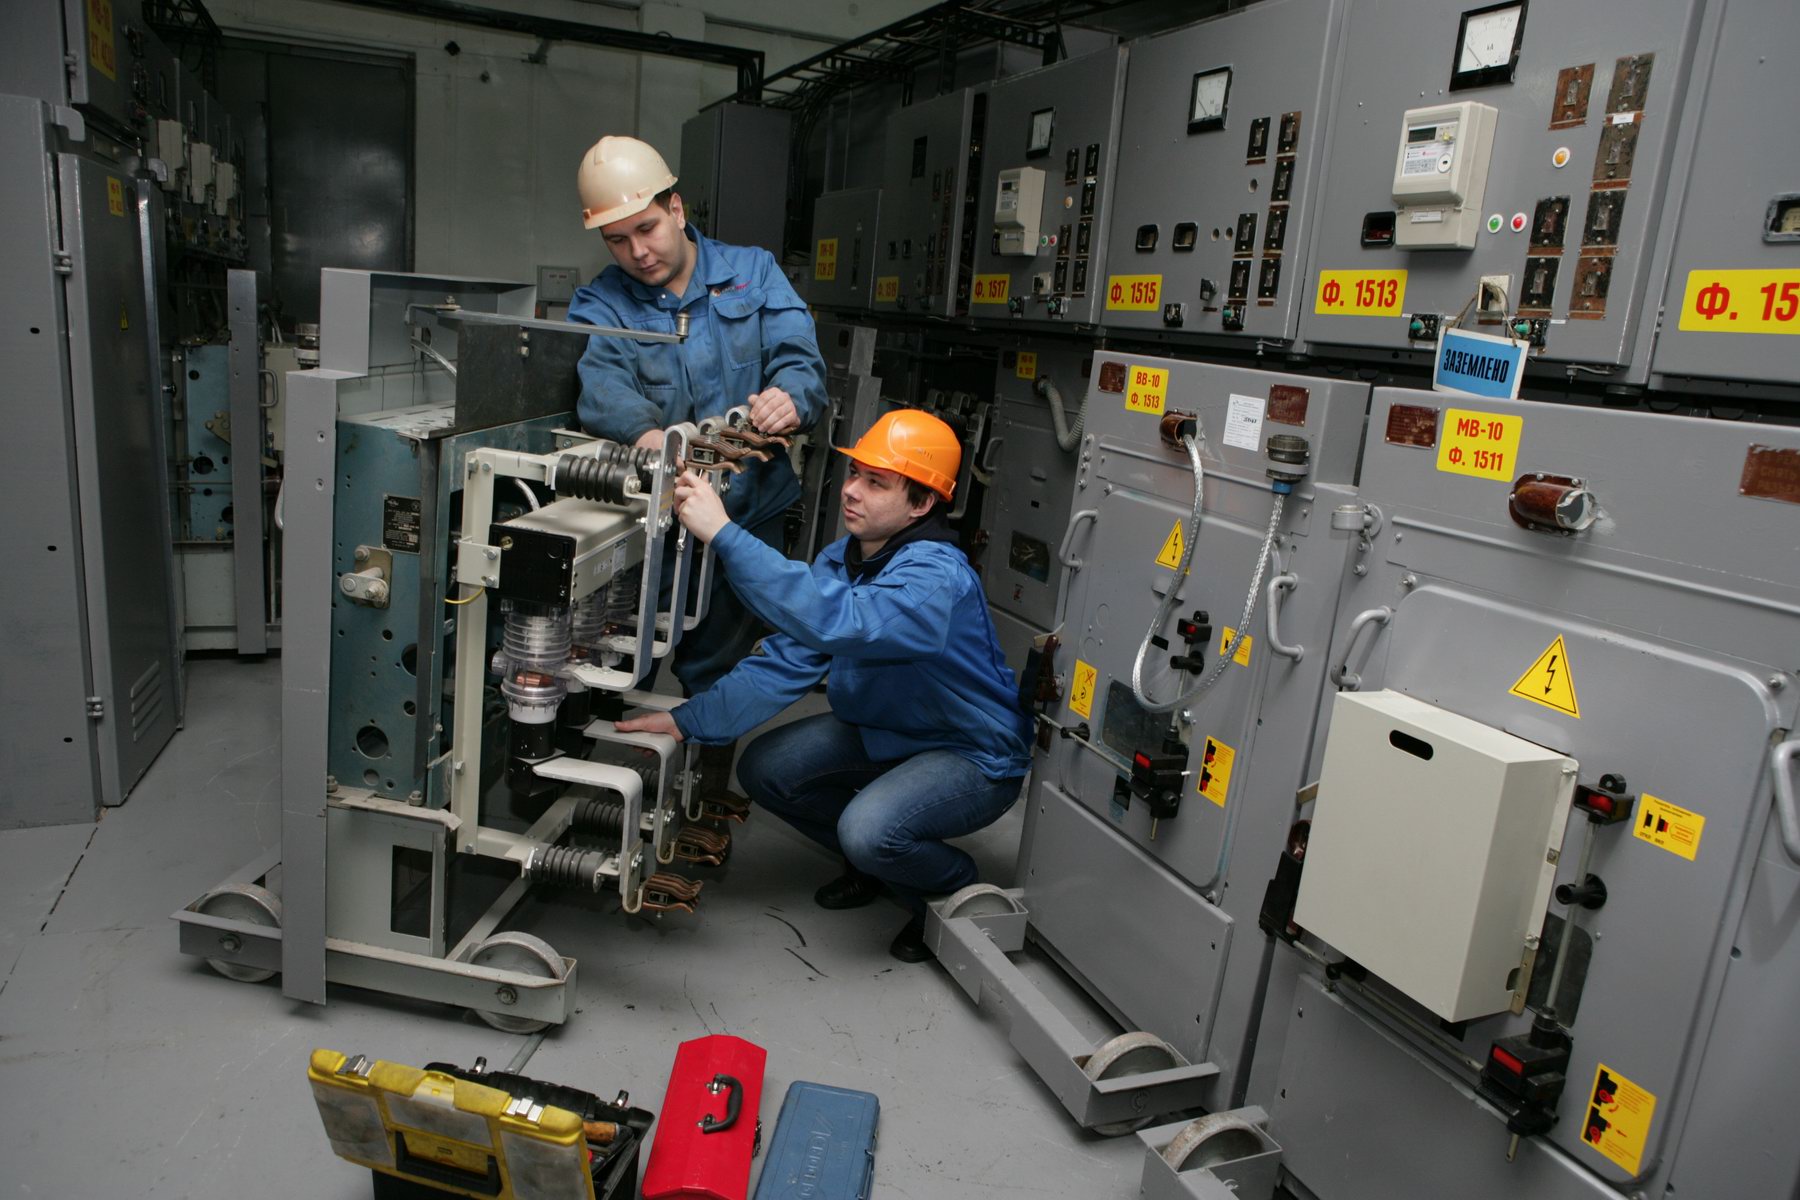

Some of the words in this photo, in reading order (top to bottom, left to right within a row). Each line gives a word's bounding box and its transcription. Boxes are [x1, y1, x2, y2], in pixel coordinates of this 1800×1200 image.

[975, 280, 985, 299] Ф.
[988, 280, 1007, 299] 1517
[1110, 282, 1125, 304] Ф.
[1130, 282, 1157, 304] 1515
[1322, 279, 1345, 307] Ф.
[1355, 279, 1398, 308] 1513
[1695, 282, 1738, 321] Ф.
[1443, 348, 1510, 384] ЗАЗЕМЛЕНО
[1135, 371, 1161, 388] ВВ-10
[1130, 392, 1141, 406] Ф.
[1143, 393, 1160, 409] 1513
[1456, 417, 1504, 441] МВ-10
[1448, 446, 1466, 465] Ф.
[1473, 449, 1504, 472] 1511
